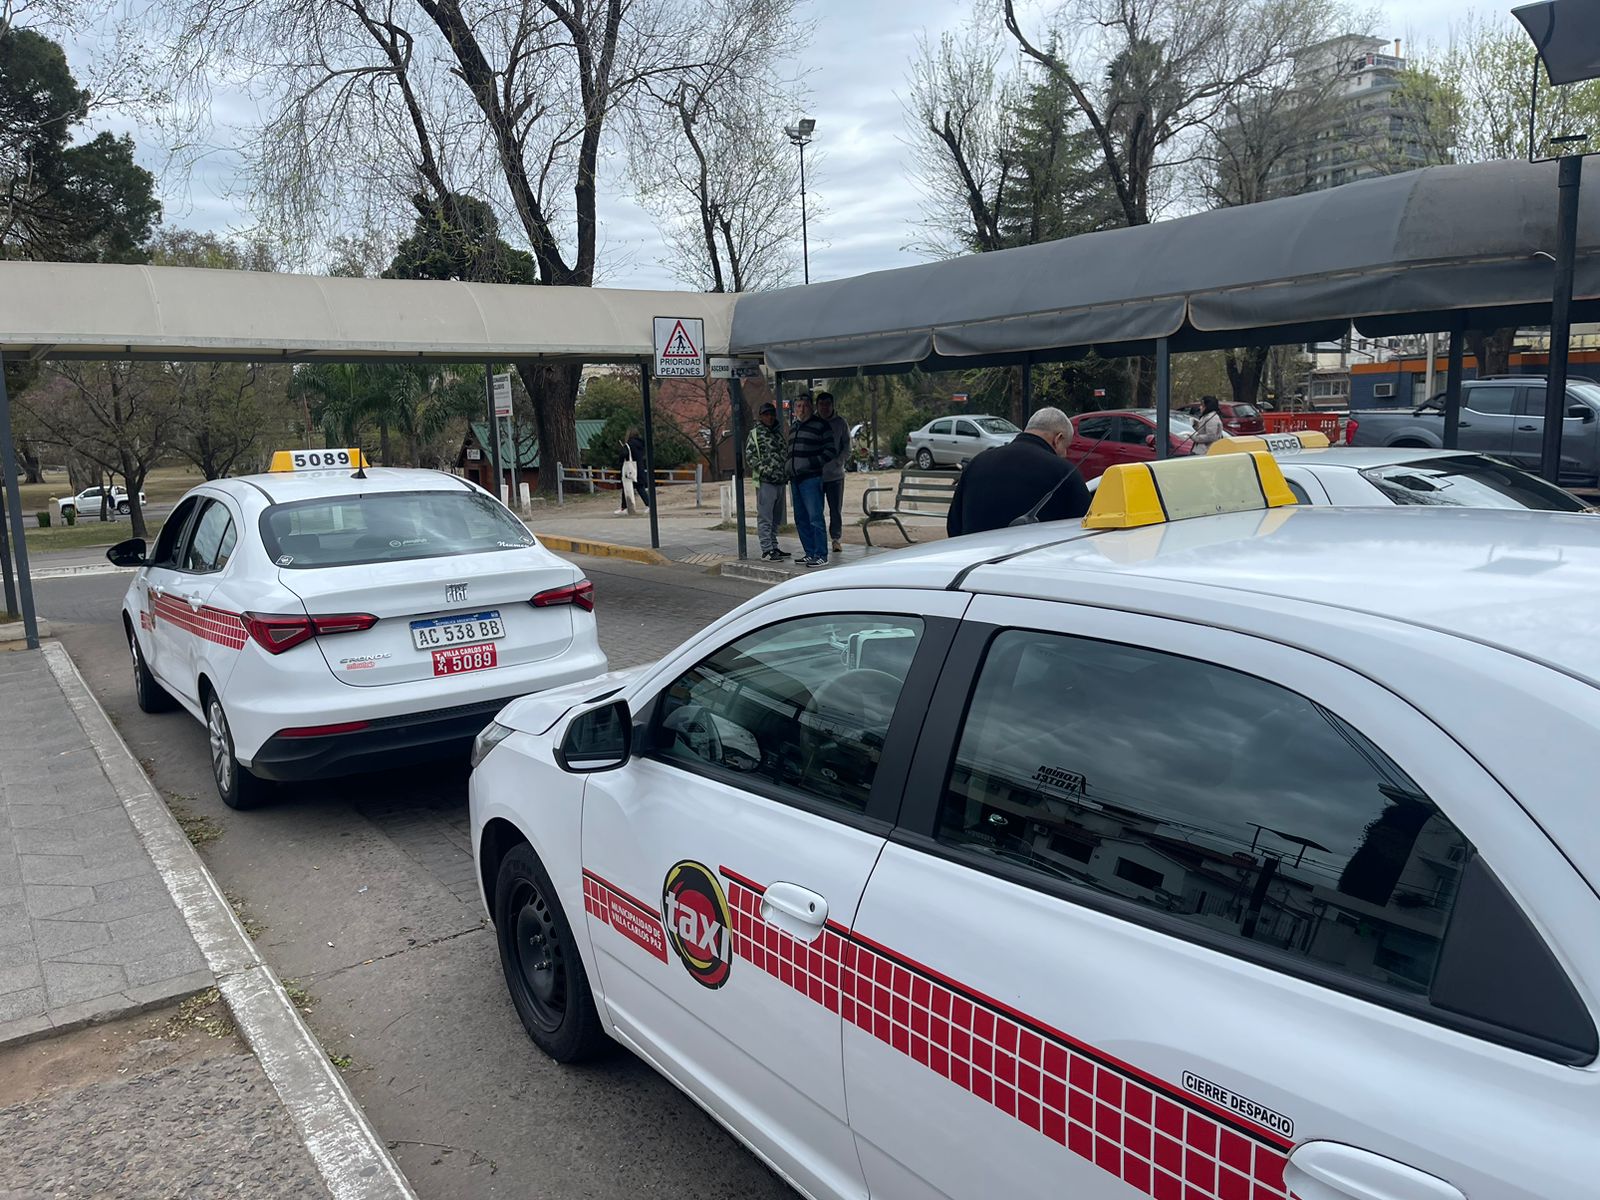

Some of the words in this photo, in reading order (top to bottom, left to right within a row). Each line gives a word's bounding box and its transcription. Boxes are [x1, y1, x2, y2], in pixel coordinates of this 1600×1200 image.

[660, 358, 700, 366] PRIORIDAD
[661, 367, 700, 375] PEATONES
[1270, 439, 1298, 451] 5006
[294, 452, 349, 467] 5089
[446, 582, 468, 602] FIAT
[419, 628, 440, 646] AC
[443, 623, 475, 642] 538
[479, 620, 500, 637] BB
[339, 652, 392, 664] CRONOS
[442, 650, 460, 658] VILLA
[460, 646, 481, 655] CARLOS
[483, 644, 494, 652] PAZ
[453, 652, 492, 671] 5089
[611, 901, 652, 934] MUNICIPALIDAD
[653, 927, 661, 940] DE
[612, 911, 627, 928] VILLA
[627, 921, 650, 944] CARLOS
[650, 936, 662, 951] PAZ
[1186, 1075, 1228, 1105] CIERRE
[1231, 1095, 1291, 1134] DESPACIO
